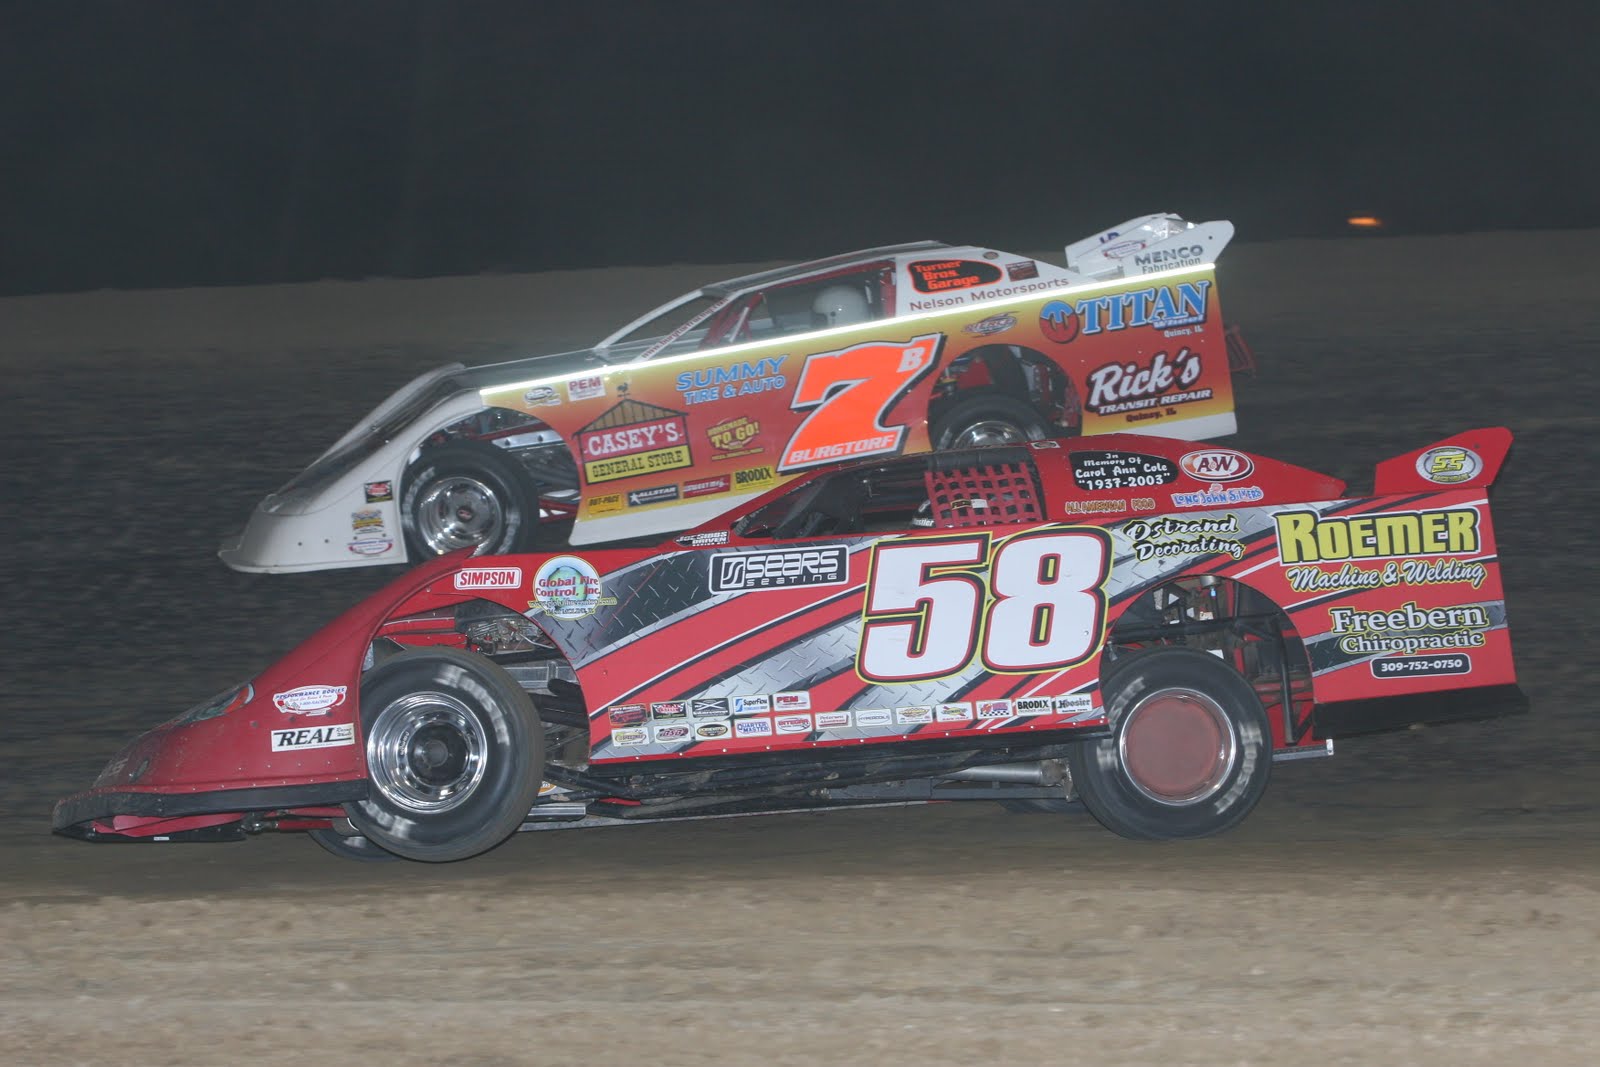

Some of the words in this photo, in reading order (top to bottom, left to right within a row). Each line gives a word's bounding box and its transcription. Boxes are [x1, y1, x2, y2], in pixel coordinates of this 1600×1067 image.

[914, 260, 962, 272] Turner
[1134, 245, 1203, 266] MENCO
[1142, 257, 1200, 274] Fabrication
[928, 275, 980, 290] Garage
[910, 296, 964, 311] Nelson
[971, 277, 1069, 302] Motorsports
[1076, 280, 1210, 334] TITAN
[676, 355, 788, 391] SUMMY
[1089, 349, 1200, 406] Rick's
[569, 377, 601, 391] PEM
[684, 387, 719, 405] TIRE
[723, 384, 736, 398] &
[739, 375, 785, 395] AUTO
[777, 332, 943, 472] 7
[896, 347, 925, 373] B
[1099, 398, 1157, 414] TRANSIT
[1161, 389, 1211, 404] REPAIR
[588, 422, 679, 456] CASEY'S
[711, 431, 732, 448] TO
[736, 422, 760, 440] GO!
[789, 434, 894, 464] BURGTORF
[592, 457, 645, 478] GENERAL
[648, 450, 683, 468] STORE
[1075, 467, 1106, 479] Carol
[1112, 466, 1137, 477] Ann
[1143, 463, 1168, 472] Cole
[1084, 458, 1126, 467] Memory
[1128, 456, 1142, 465] Of
[1195, 455, 1235, 473] A&W
[736, 467, 772, 484] BRODIX
[637, 486, 676, 498] ALLSTAR
[1174, 494, 1199, 505] LONG
[1126, 517, 1238, 541] Ostrand
[1275, 510, 1478, 563] ROEMER
[1136, 536, 1244, 560] Decorating
[746, 550, 839, 579] SEARS
[1288, 564, 1380, 590] Machine
[1383, 563, 1399, 583] &
[1401, 560, 1486, 587] Welding
[460, 571, 515, 586] SIMPSON
[538, 576, 575, 587] Global
[579, 575, 599, 585] Fire
[535, 586, 580, 597] Control,
[859, 529, 1109, 681] 58
[1331, 602, 1486, 633] Freebern
[1341, 630, 1483, 654] Chiropractic
[1381, 659, 1462, 672] 309-752-0750
[275, 689, 320, 700] PERFORMANCE
[322, 687, 345, 695] BODIES
[743, 698, 768, 706] SuperFlow
[1058, 698, 1091, 708] Hoosier
[1017, 700, 1049, 709] BRODIX
[274, 728, 352, 747] REAL
